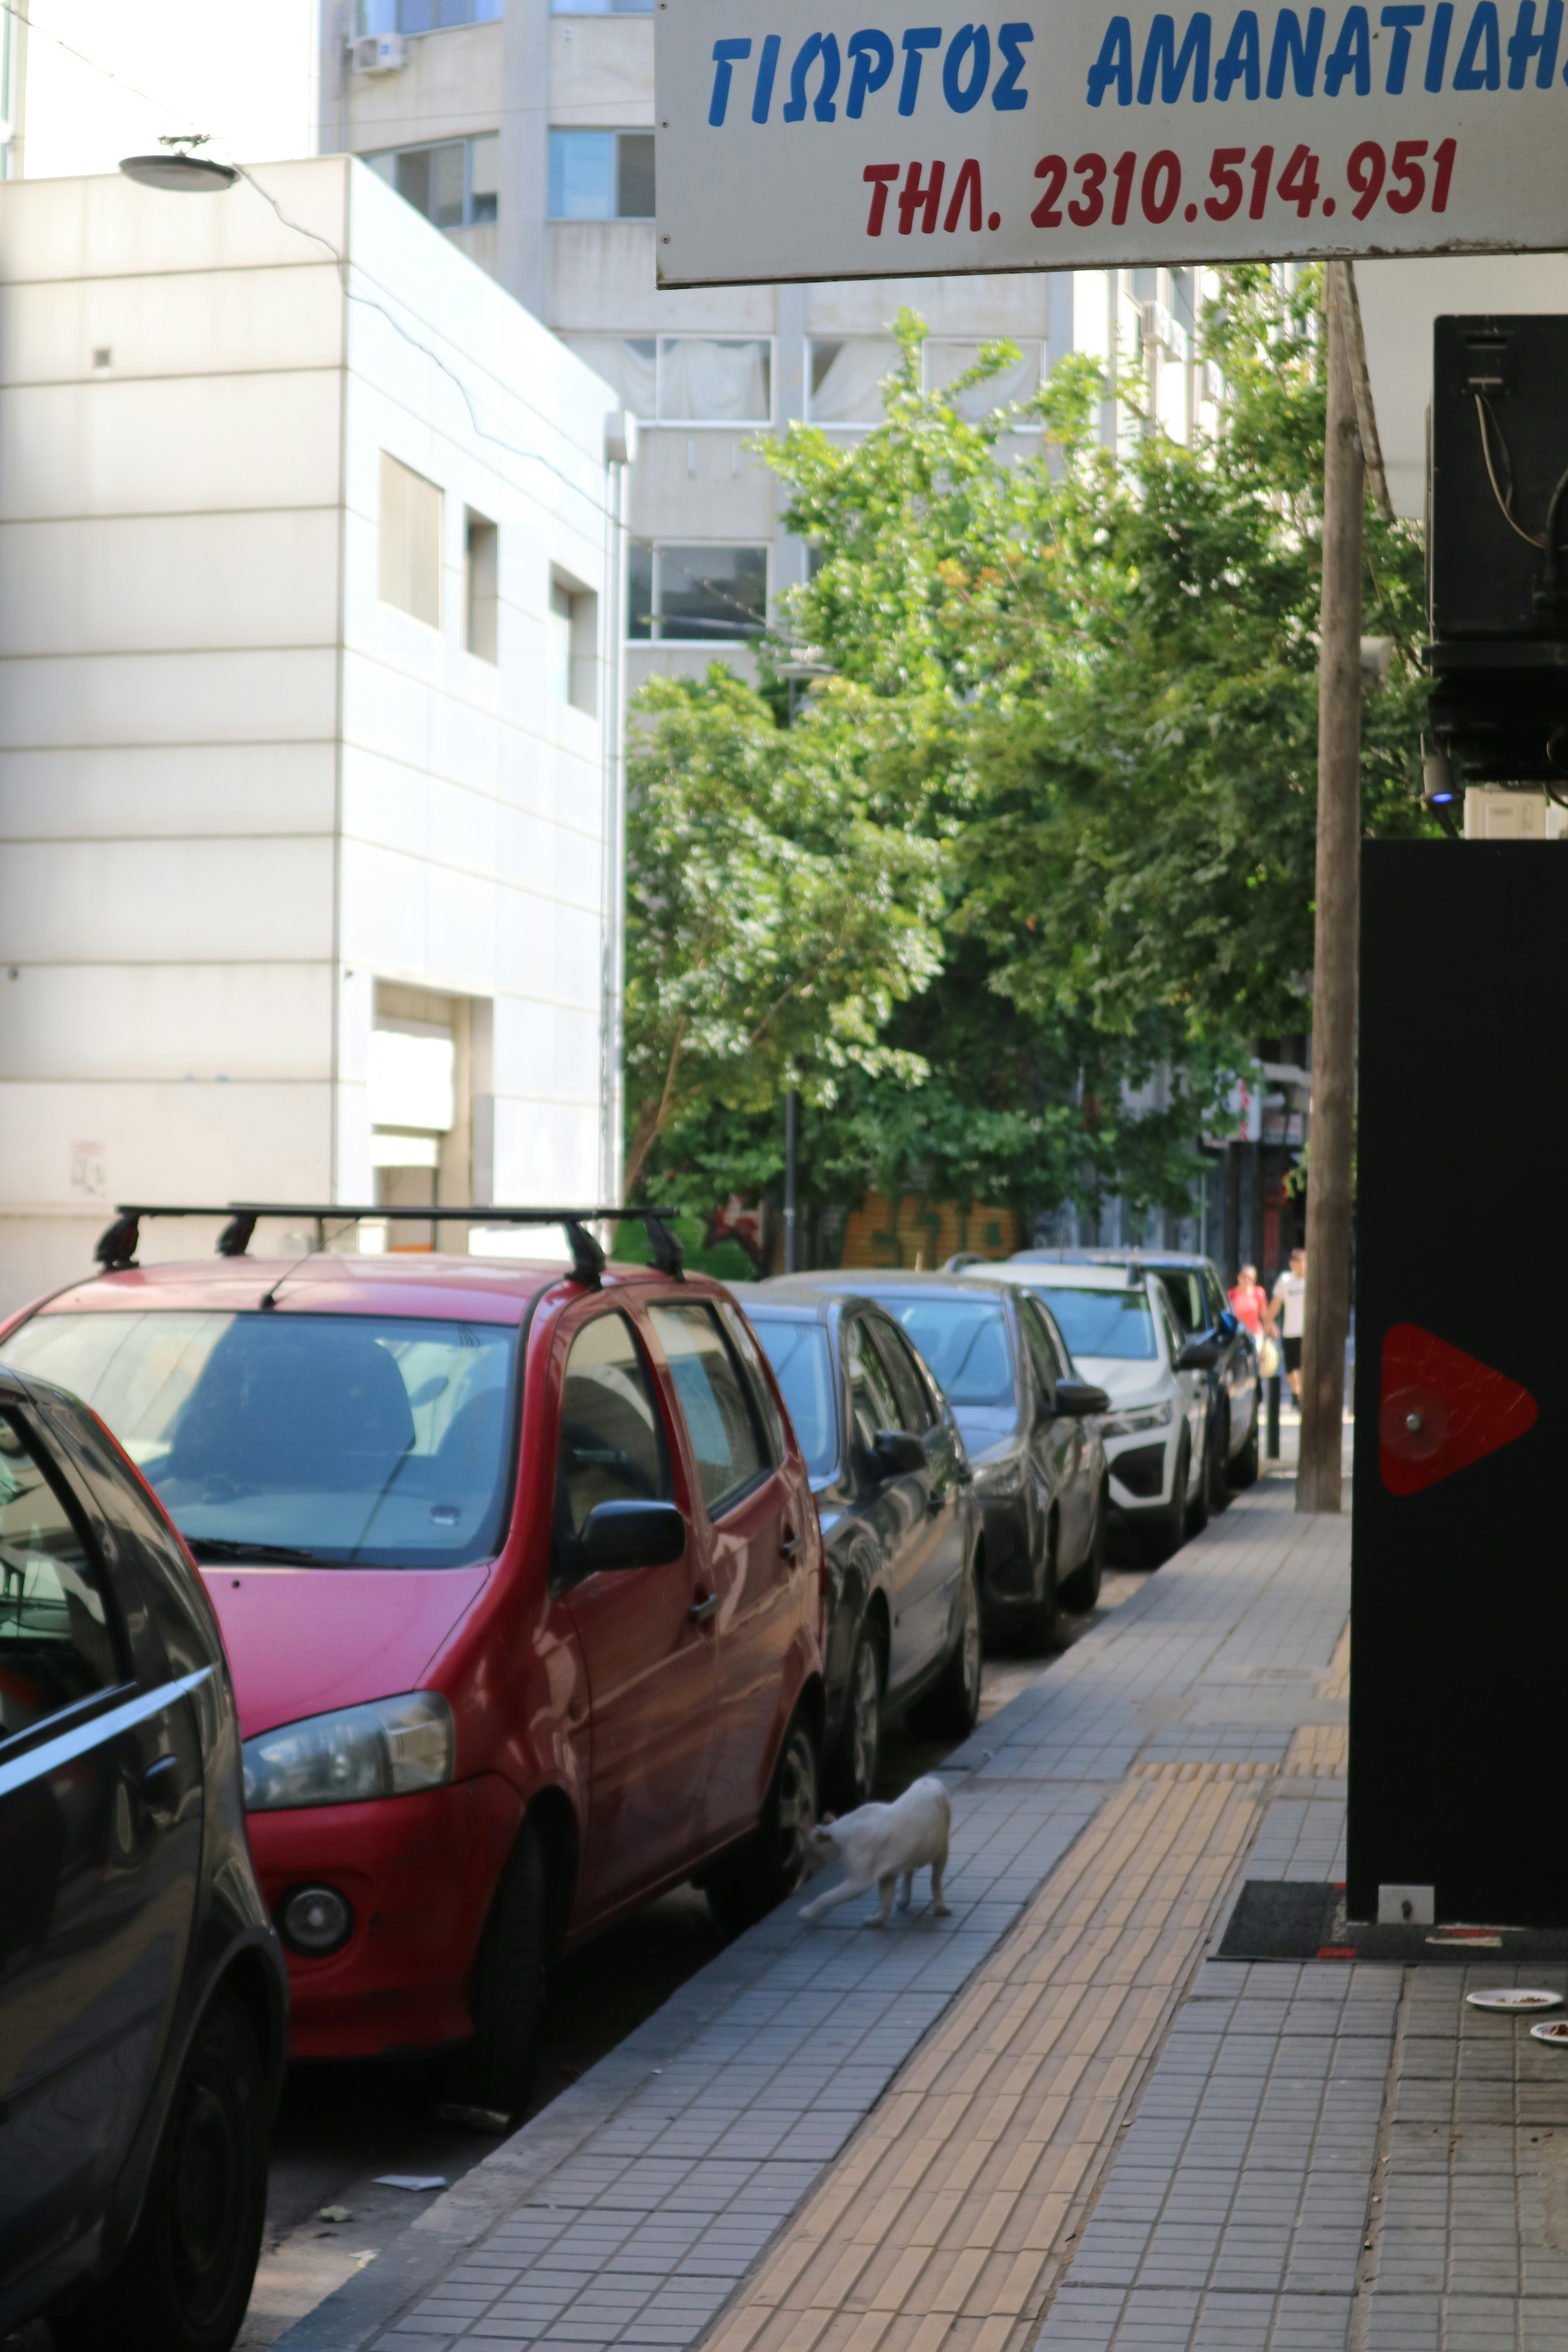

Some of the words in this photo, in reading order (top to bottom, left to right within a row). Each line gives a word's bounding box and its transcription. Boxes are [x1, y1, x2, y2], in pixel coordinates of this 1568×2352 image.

[708, 23, 1034, 128] ΓΙΩΡΓΟΣ
[1087, 0, 1568, 107] ΑΜΑΝΑΤΙΔΗ
[864, 159, 1001, 236] ΤΗΛ.
[1031, 139, 1456, 227] 2310.514.951
